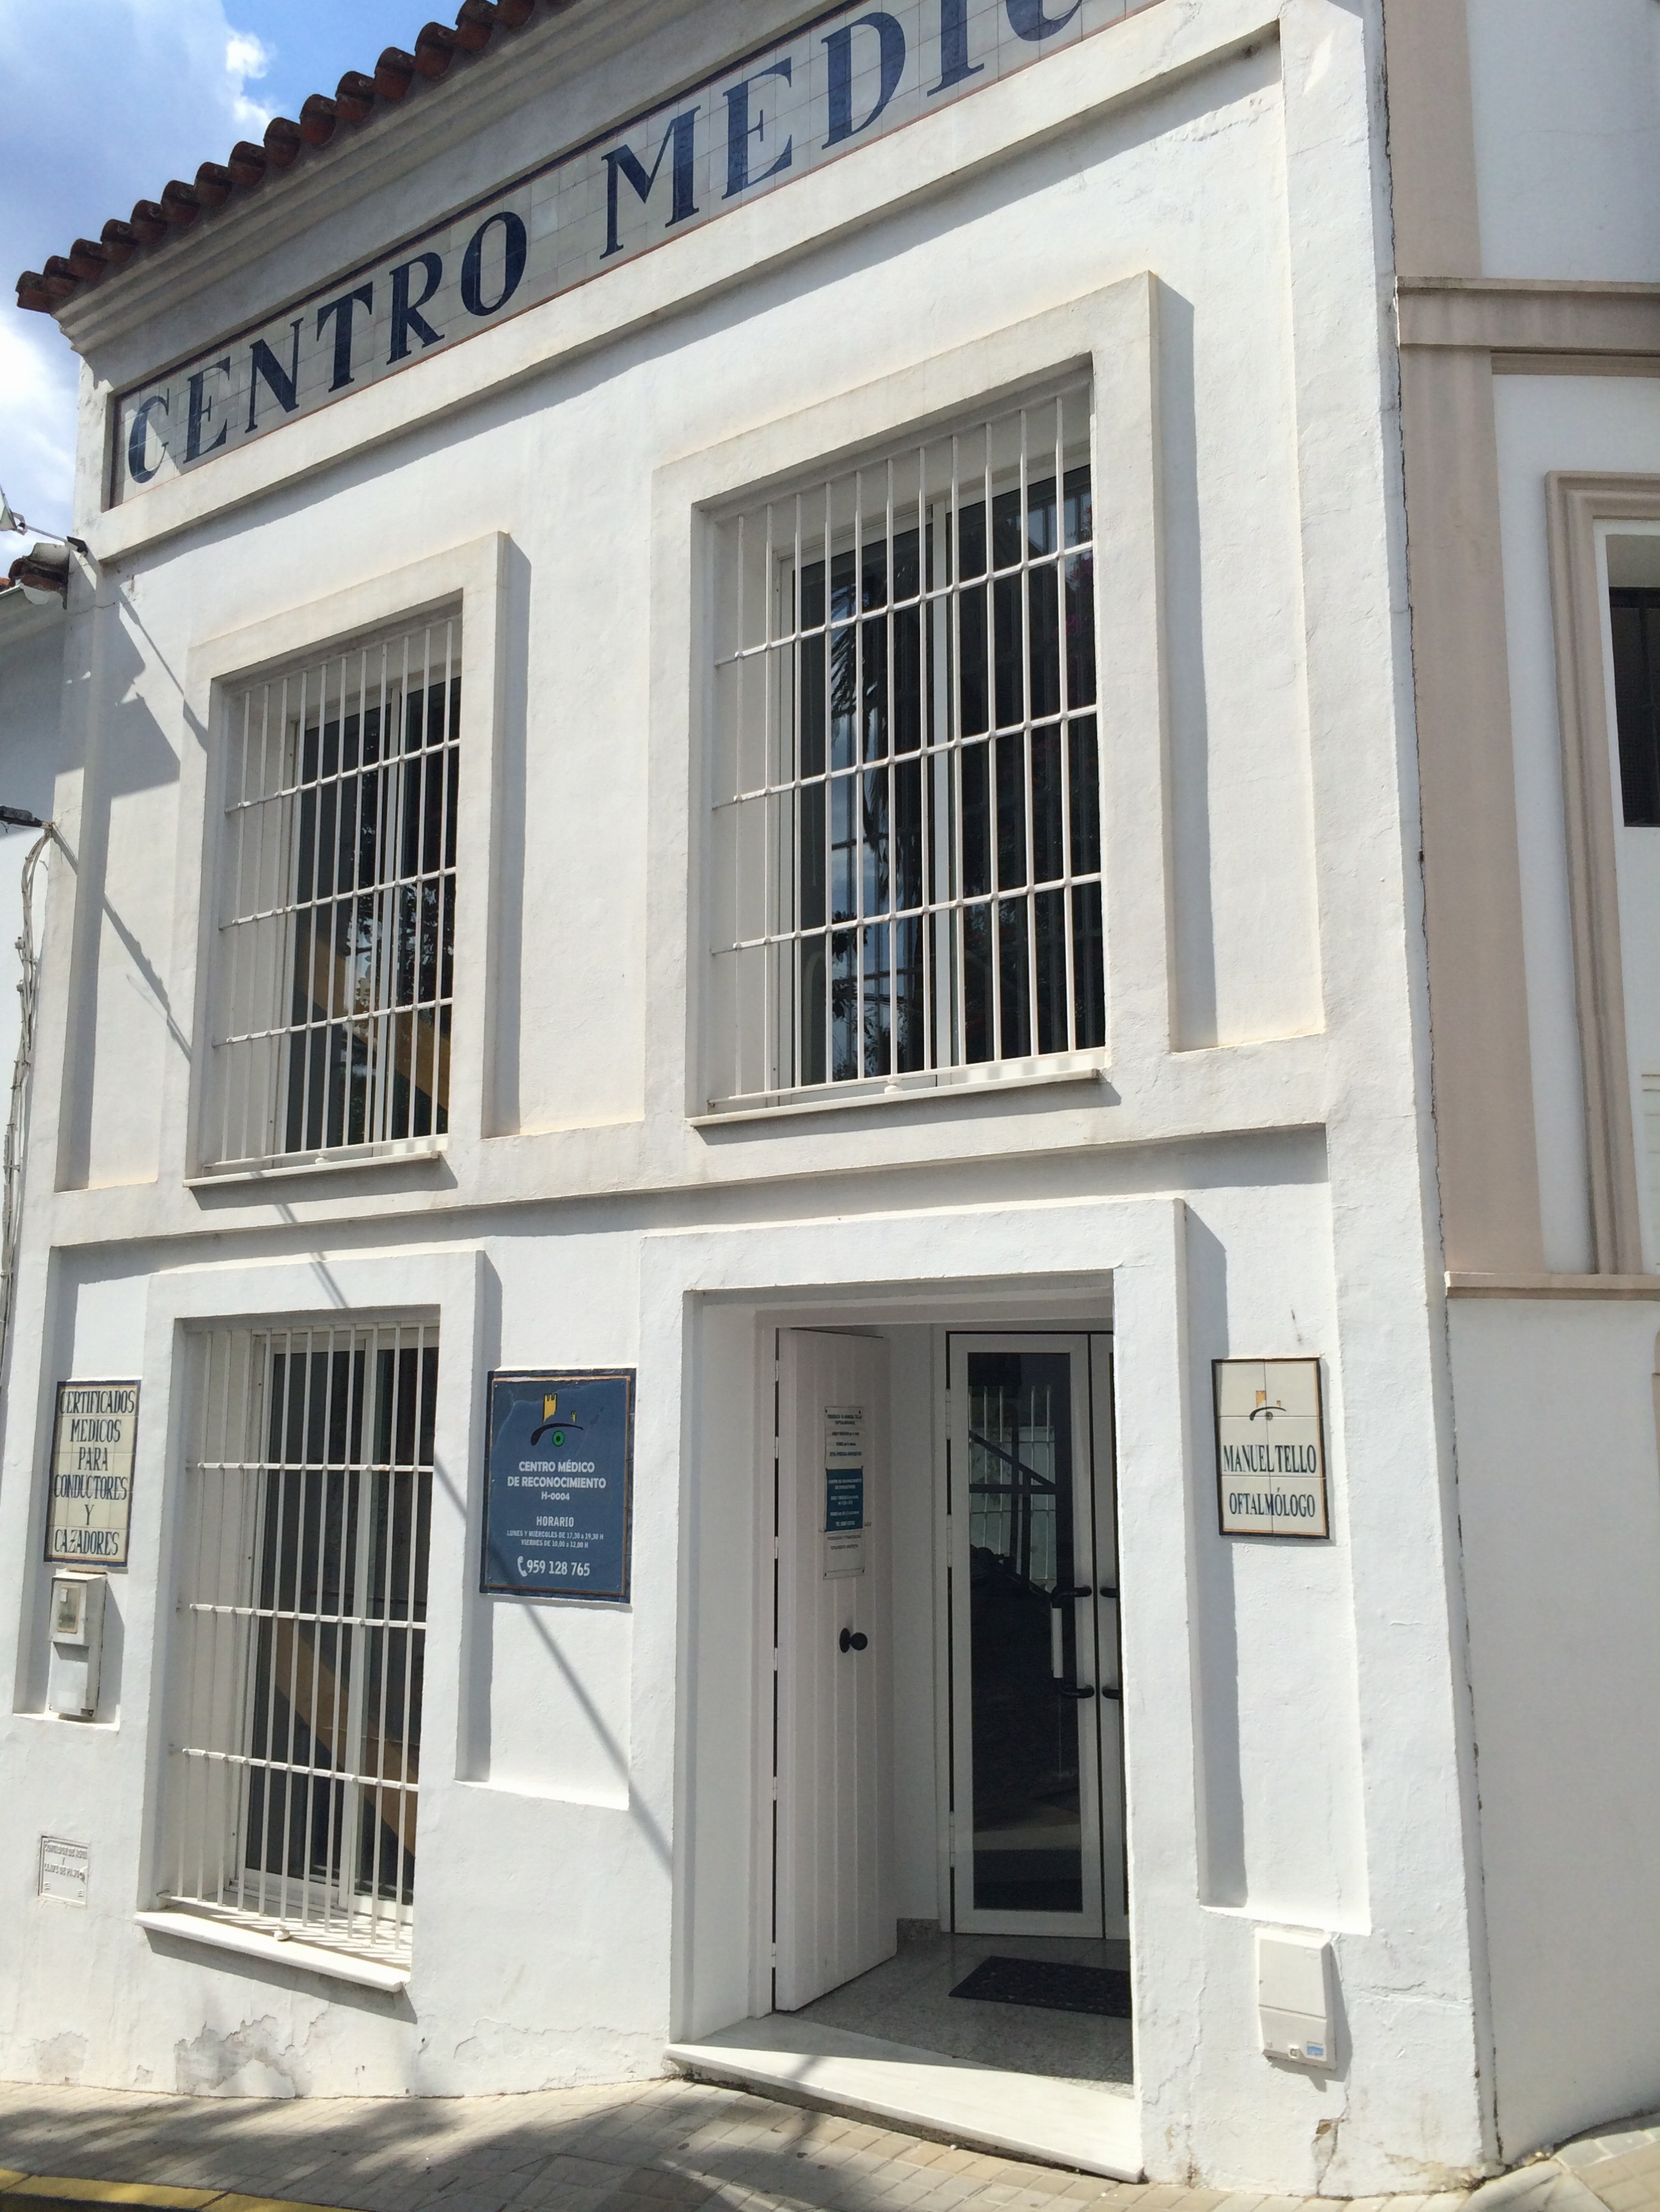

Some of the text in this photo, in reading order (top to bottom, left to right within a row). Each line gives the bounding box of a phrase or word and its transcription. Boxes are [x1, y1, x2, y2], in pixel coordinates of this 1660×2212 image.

[127, 212, 528, 484] CENTRO
[60, 1390, 135, 1413] CERTIFICADOS
[70, 1419, 121, 1443] MEDICOS
[77, 1447, 108, 1471] PARA
[519, 1459, 595, 1472] CENTRO MÉDICO
[1223, 1445, 1316, 1474] MANUEL TELLO
[54, 1474, 128, 1500] CONDUCTORES
[507, 1476, 607, 1489] DE RECONOCIMIENTO
[541, 1491, 570, 1501] H-0004
[1229, 1487, 1316, 1517] OFTALMÓLOGO
[84, 1504, 94, 1525] Y
[536, 1516, 574, 1527] HORARIO
[54, 1529, 119, 1555] CAZADORES
[527, 1559, 590, 1576] 959 128 765
